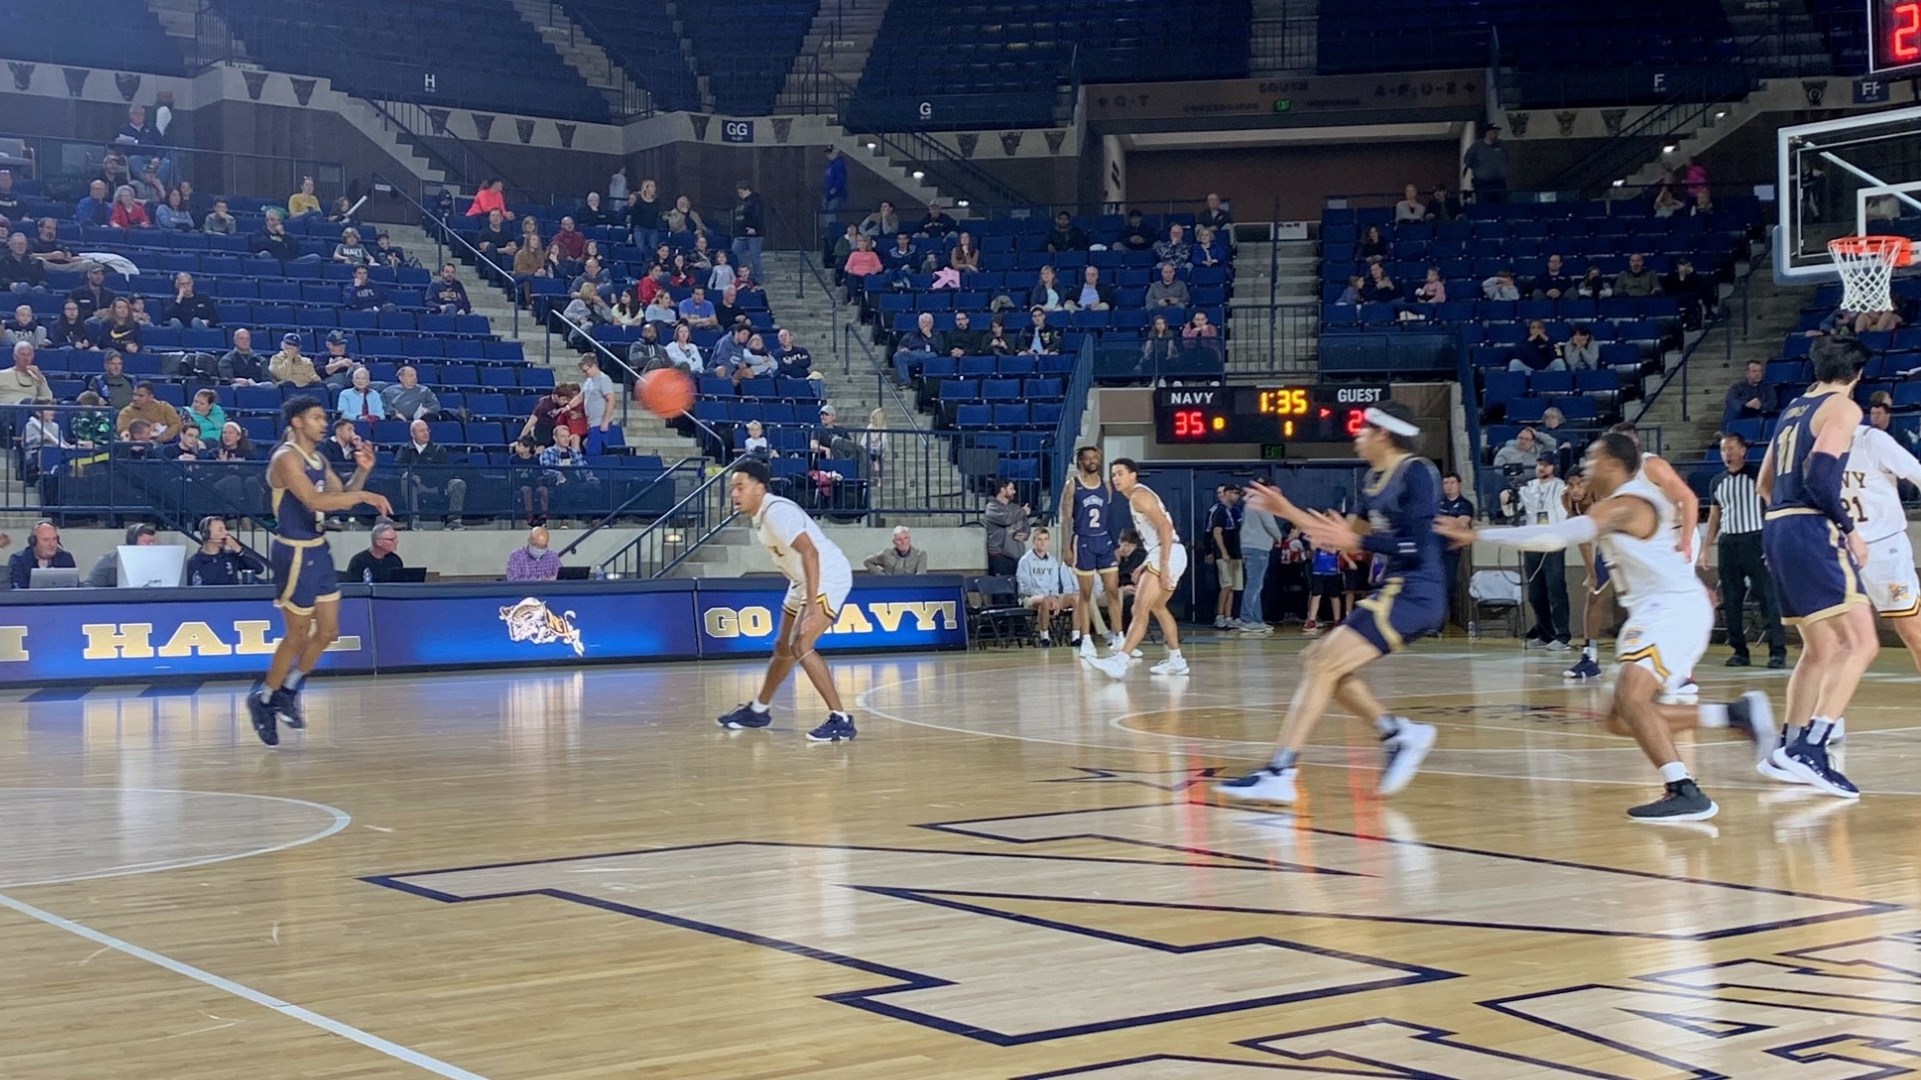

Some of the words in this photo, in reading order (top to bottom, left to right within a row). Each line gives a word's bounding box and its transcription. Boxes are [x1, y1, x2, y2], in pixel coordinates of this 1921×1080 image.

[425, 73, 435, 88] H
[1654, 74, 1665, 87] F
[920, 102, 931, 115] G
[727, 122, 748, 136] GG
[1171, 392, 1214, 405] NAVY
[1260, 389, 1307, 414] 1:35
[1337, 388, 1382, 403] GUEST
[1175, 411, 1204, 435] 35
[1088, 508, 1101, 528] 2
[704, 606, 773, 638] GO
[824, 601, 957, 635] AVY!
